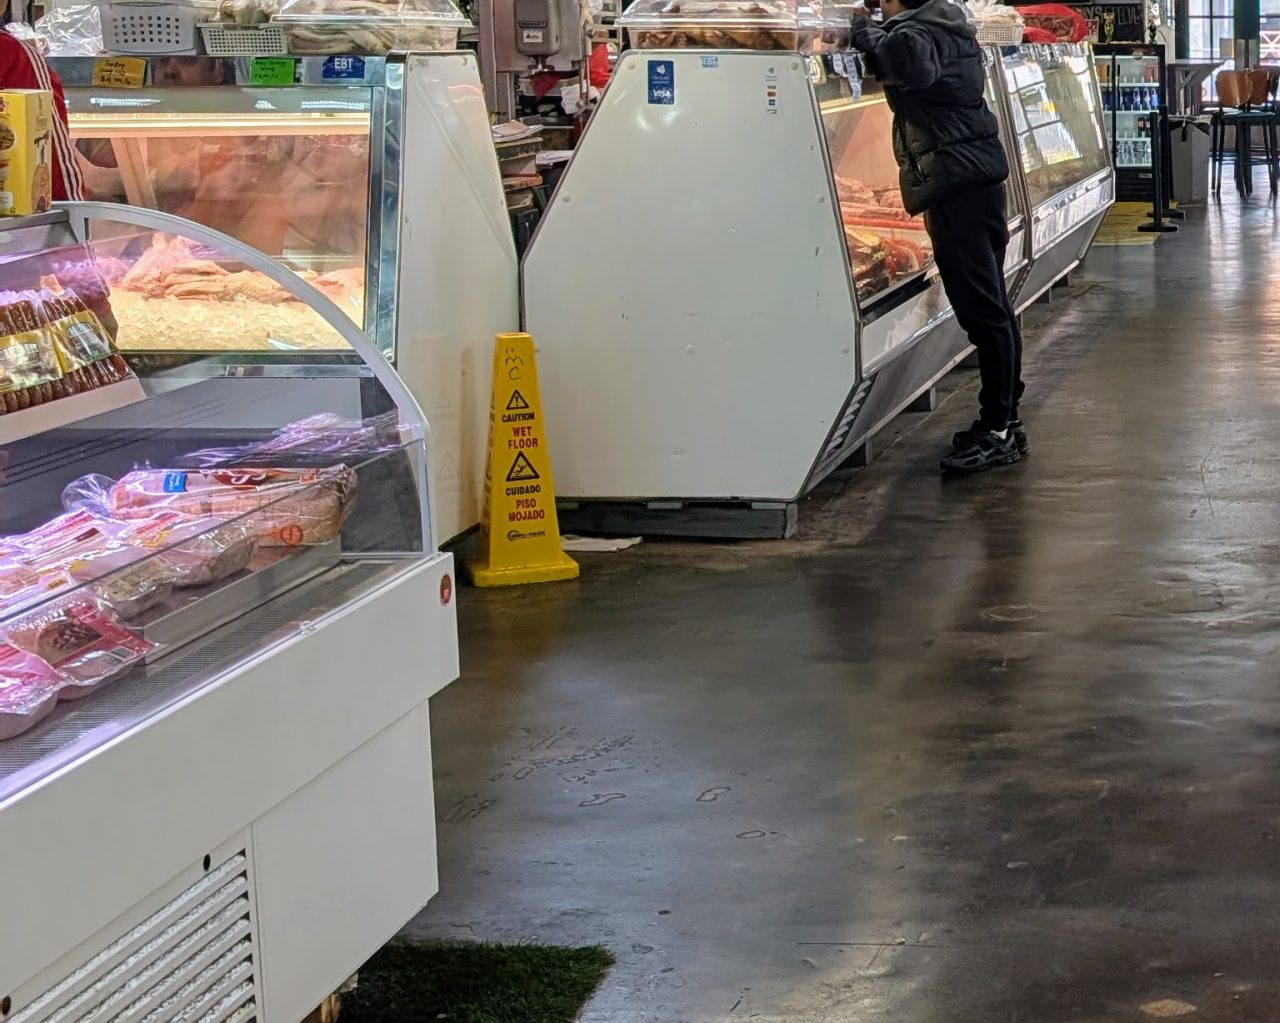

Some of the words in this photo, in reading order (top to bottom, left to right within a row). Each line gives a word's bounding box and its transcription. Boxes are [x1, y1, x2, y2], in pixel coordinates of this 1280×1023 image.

[334, 57, 354, 70] EBT
[653, 89, 671, 97] VISA
[501, 412, 536, 424] CAUTION
[512, 425, 533, 438] WET
[507, 437, 539, 450] FLOOR
[505, 484, 542, 497] CUIDADO
[515, 498, 537, 510] PISO
[508, 509, 546, 523] MOJADO
